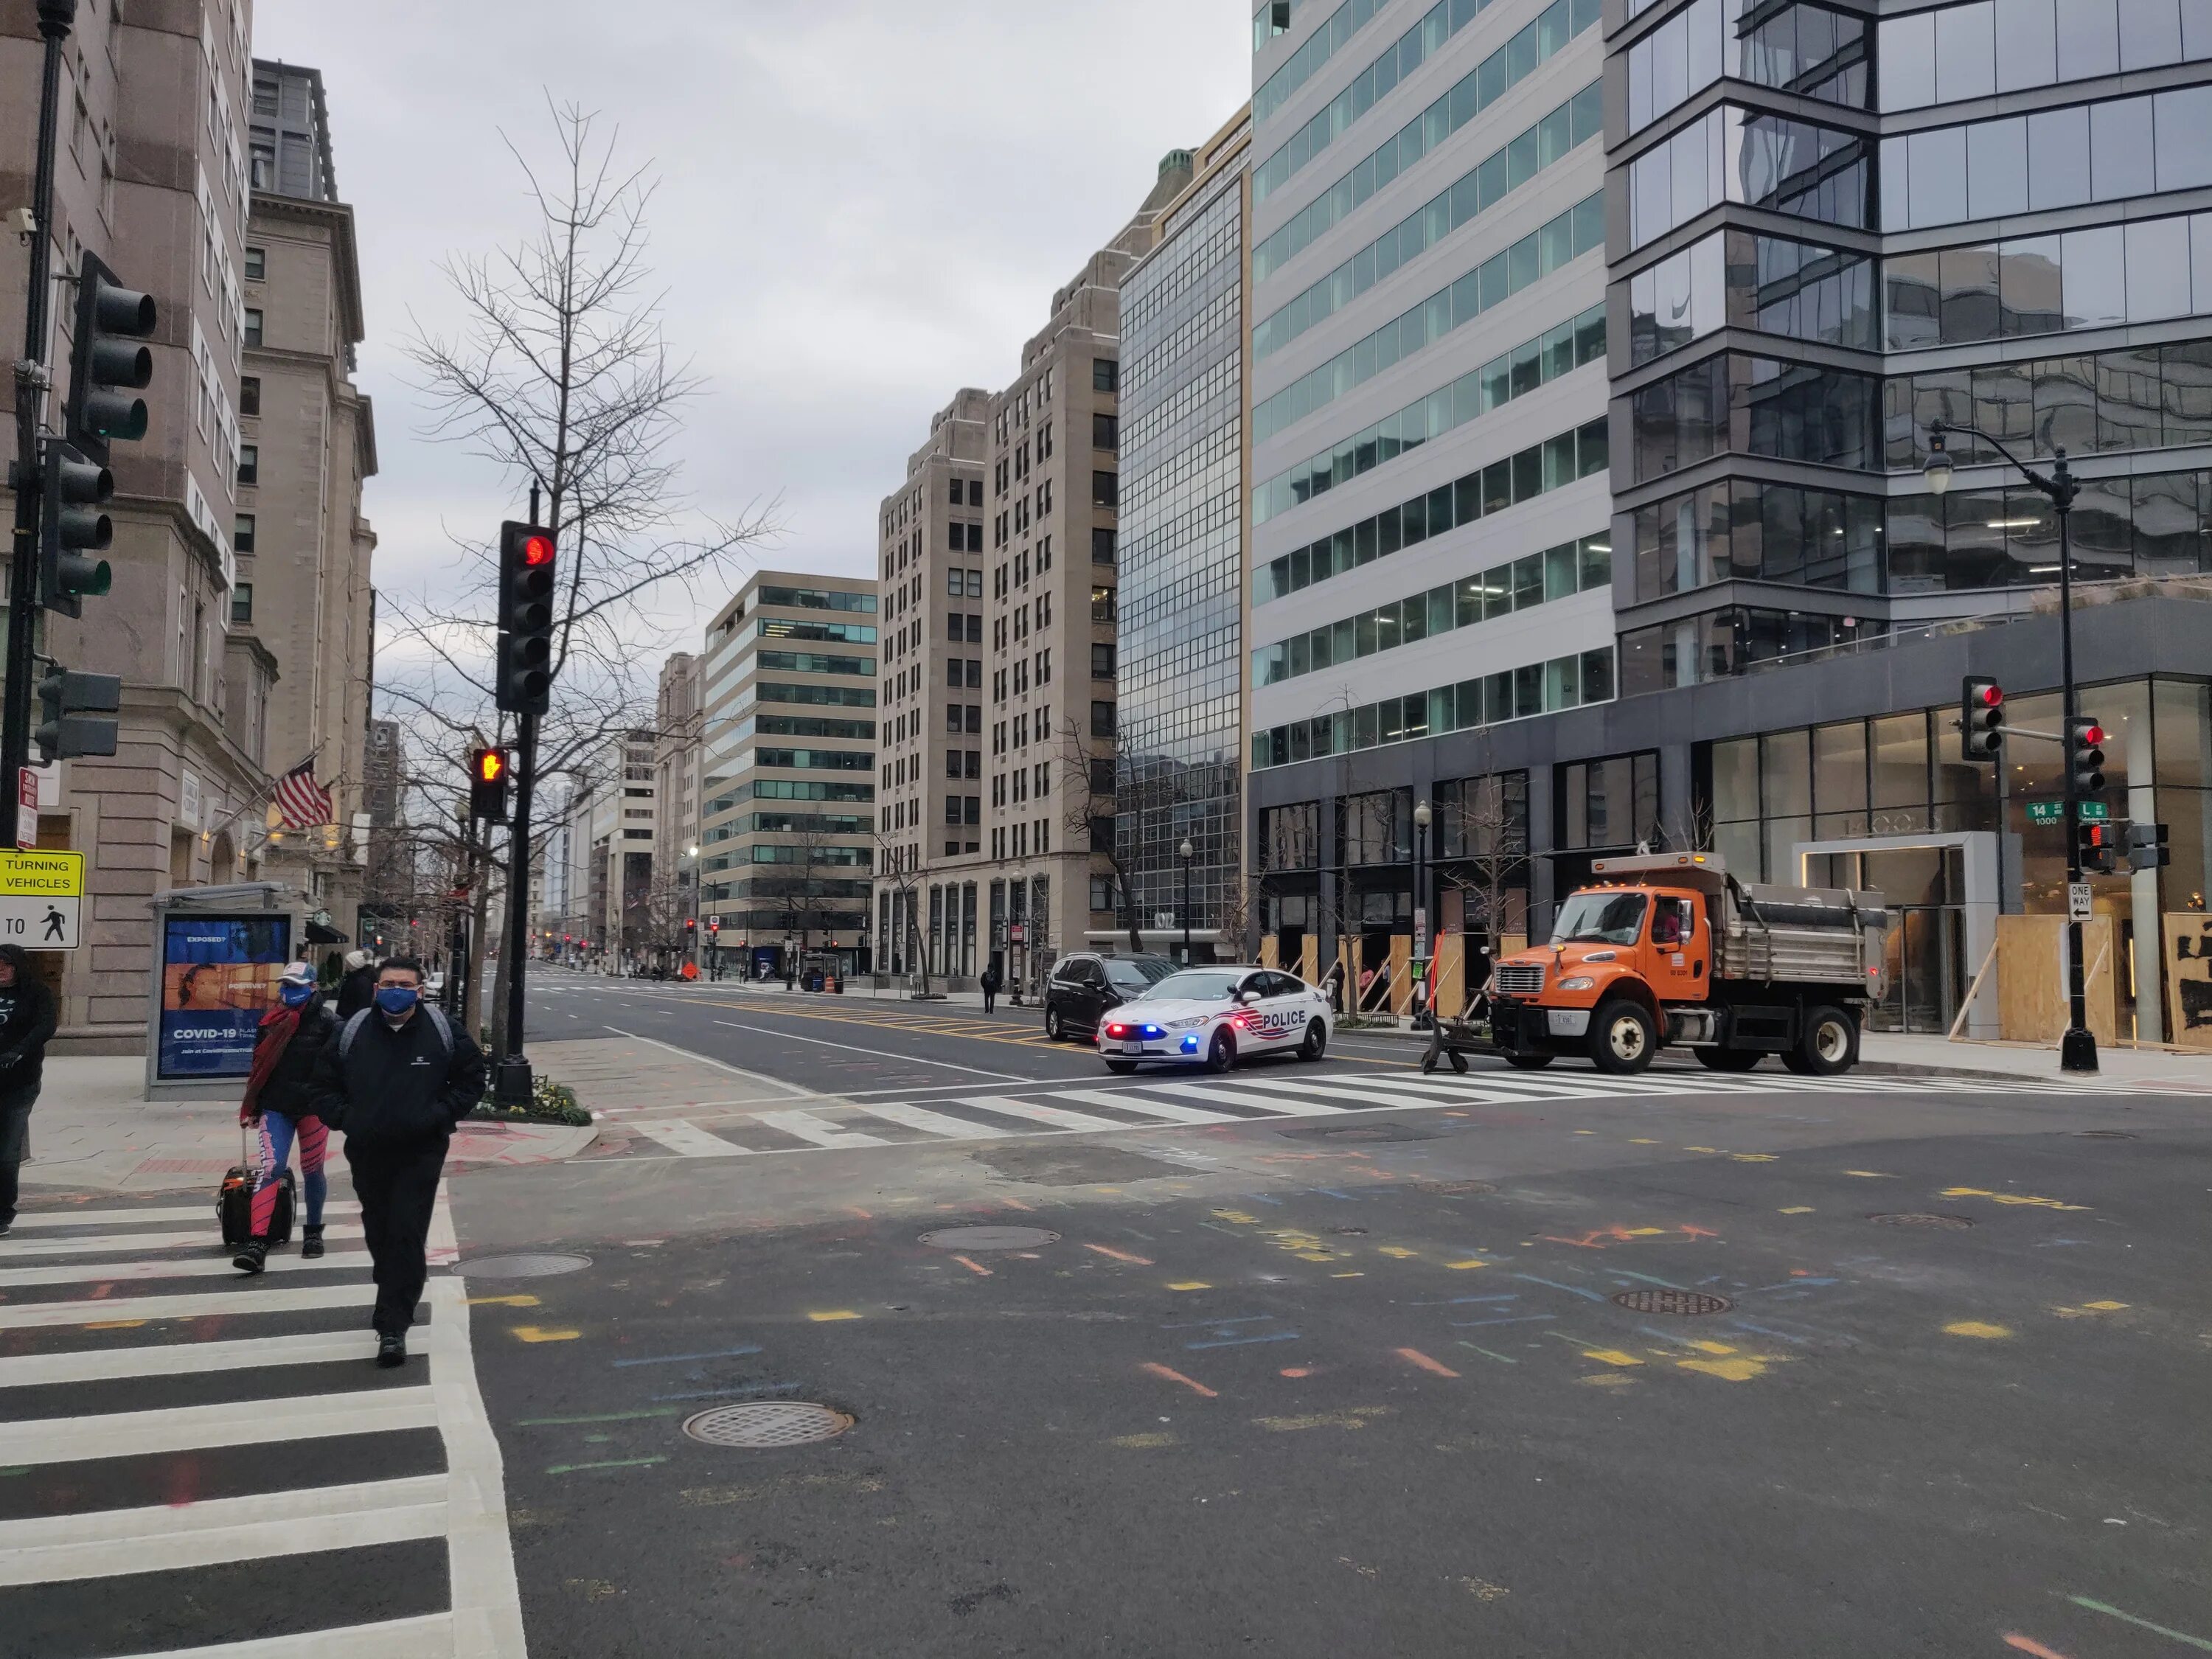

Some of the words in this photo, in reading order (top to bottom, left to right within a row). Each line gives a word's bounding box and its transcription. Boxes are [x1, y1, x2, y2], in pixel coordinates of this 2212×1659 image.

[2033, 804, 2046, 816] 14
[2083, 804, 2090, 815] L
[2036, 817, 2057, 825] 1000
[6, 860, 69, 872] TURNING
[6, 877, 71, 889] VEHICLES
[2073, 886, 2089, 895] ONE
[2073, 897, 2090, 906] WAY
[6, 918, 25, 934] TO
[1263, 1010, 1306, 1029] POLICE
[173, 1028, 237, 1040] COVID-19
